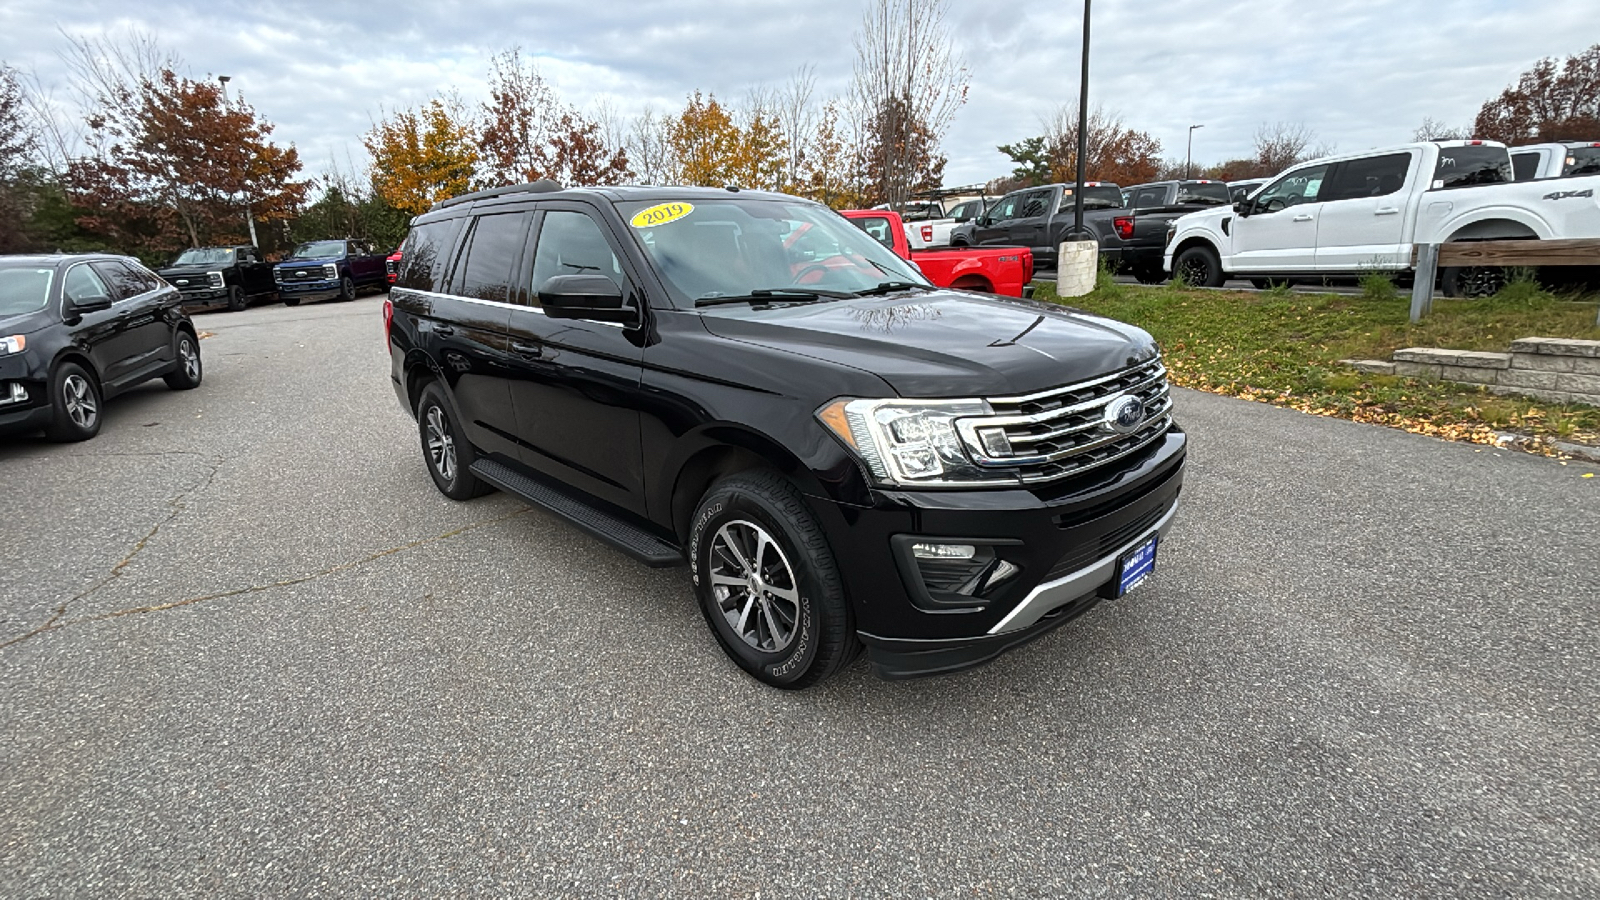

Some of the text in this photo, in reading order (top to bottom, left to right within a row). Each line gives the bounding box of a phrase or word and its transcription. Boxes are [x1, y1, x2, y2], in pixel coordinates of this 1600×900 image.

[643, 204, 684, 224] 2019
[691, 502, 722, 587] GOODYEAR
[772, 597, 811, 677] WRANGLER
